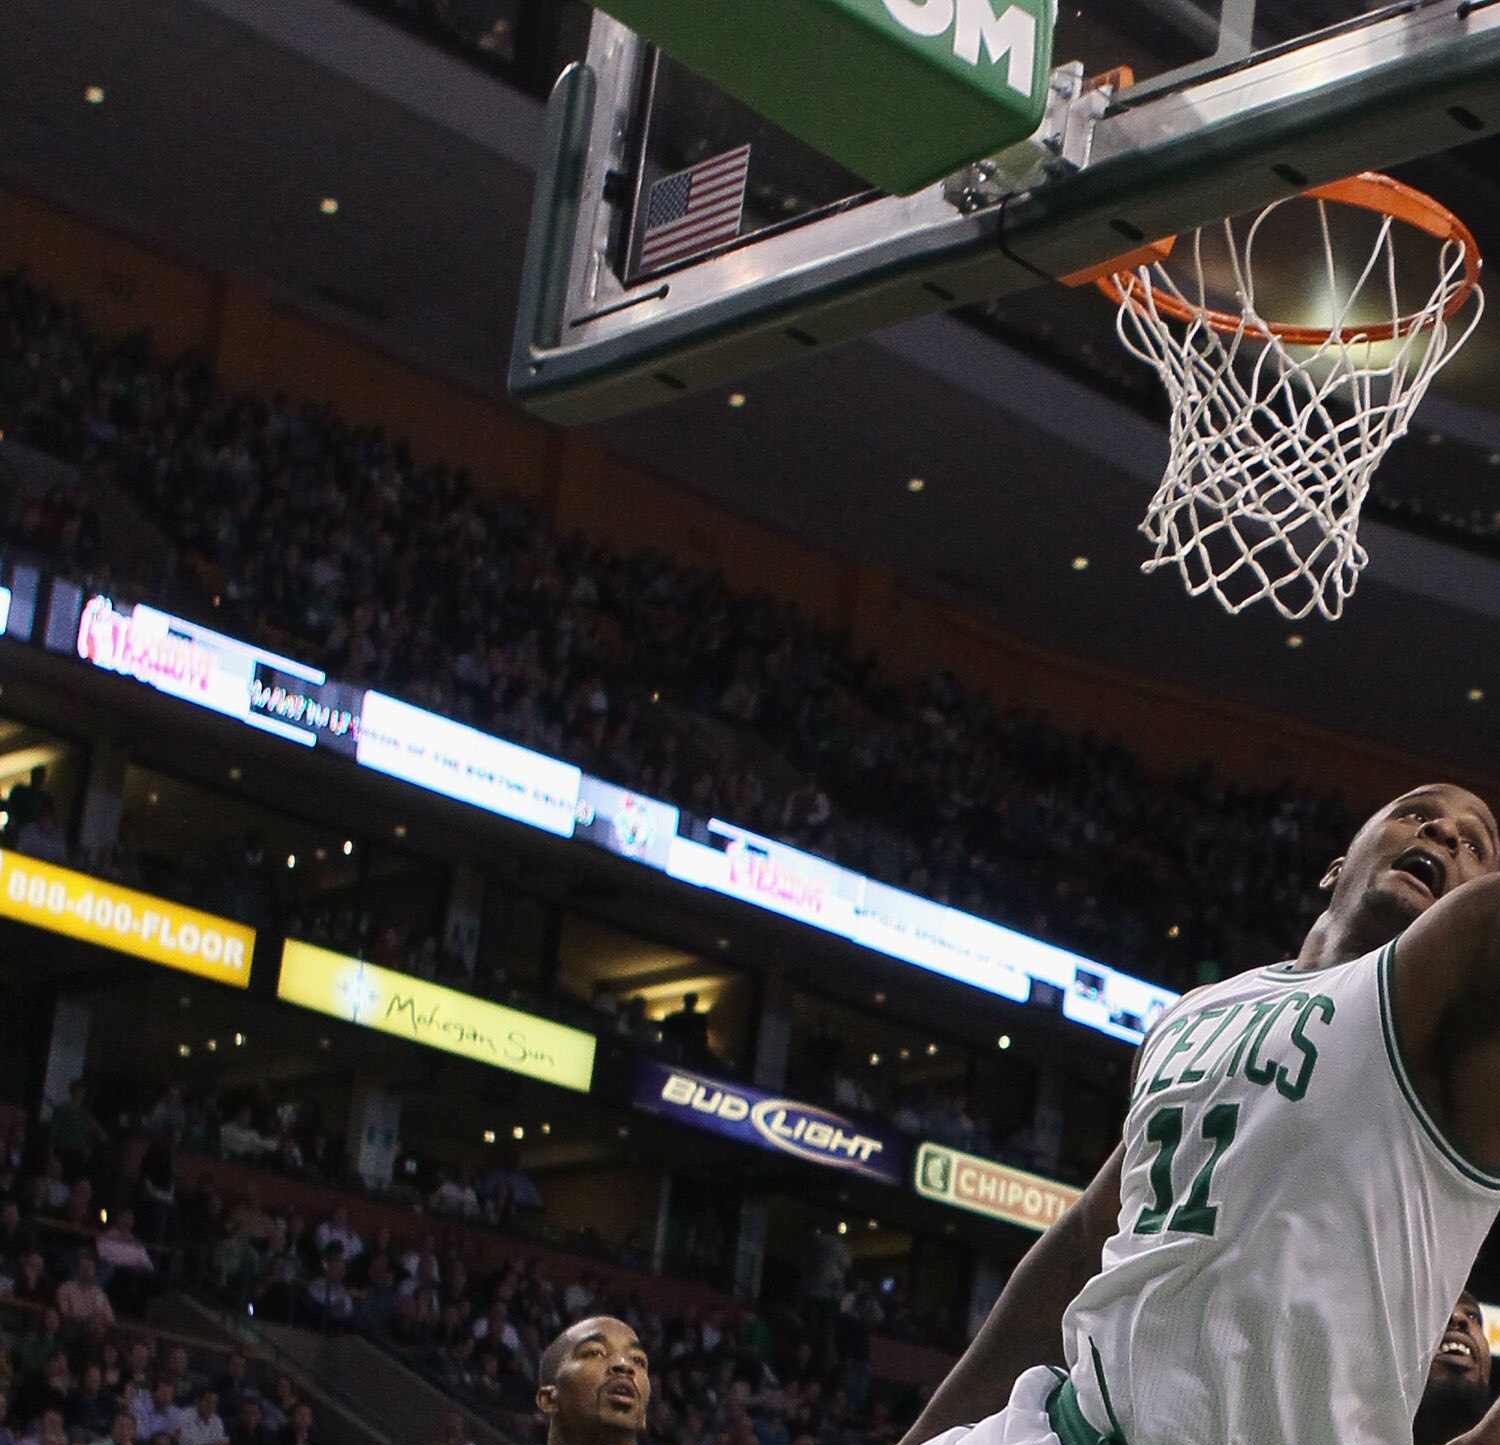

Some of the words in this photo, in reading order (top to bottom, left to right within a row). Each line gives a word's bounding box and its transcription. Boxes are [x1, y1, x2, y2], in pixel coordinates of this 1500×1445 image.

[503, 1031, 556, 1066] Sun
[660, 1073, 750, 1122] BUD
[770, 1110, 883, 1163] LIGHT
[1132, 1103, 1241, 1236] 11
